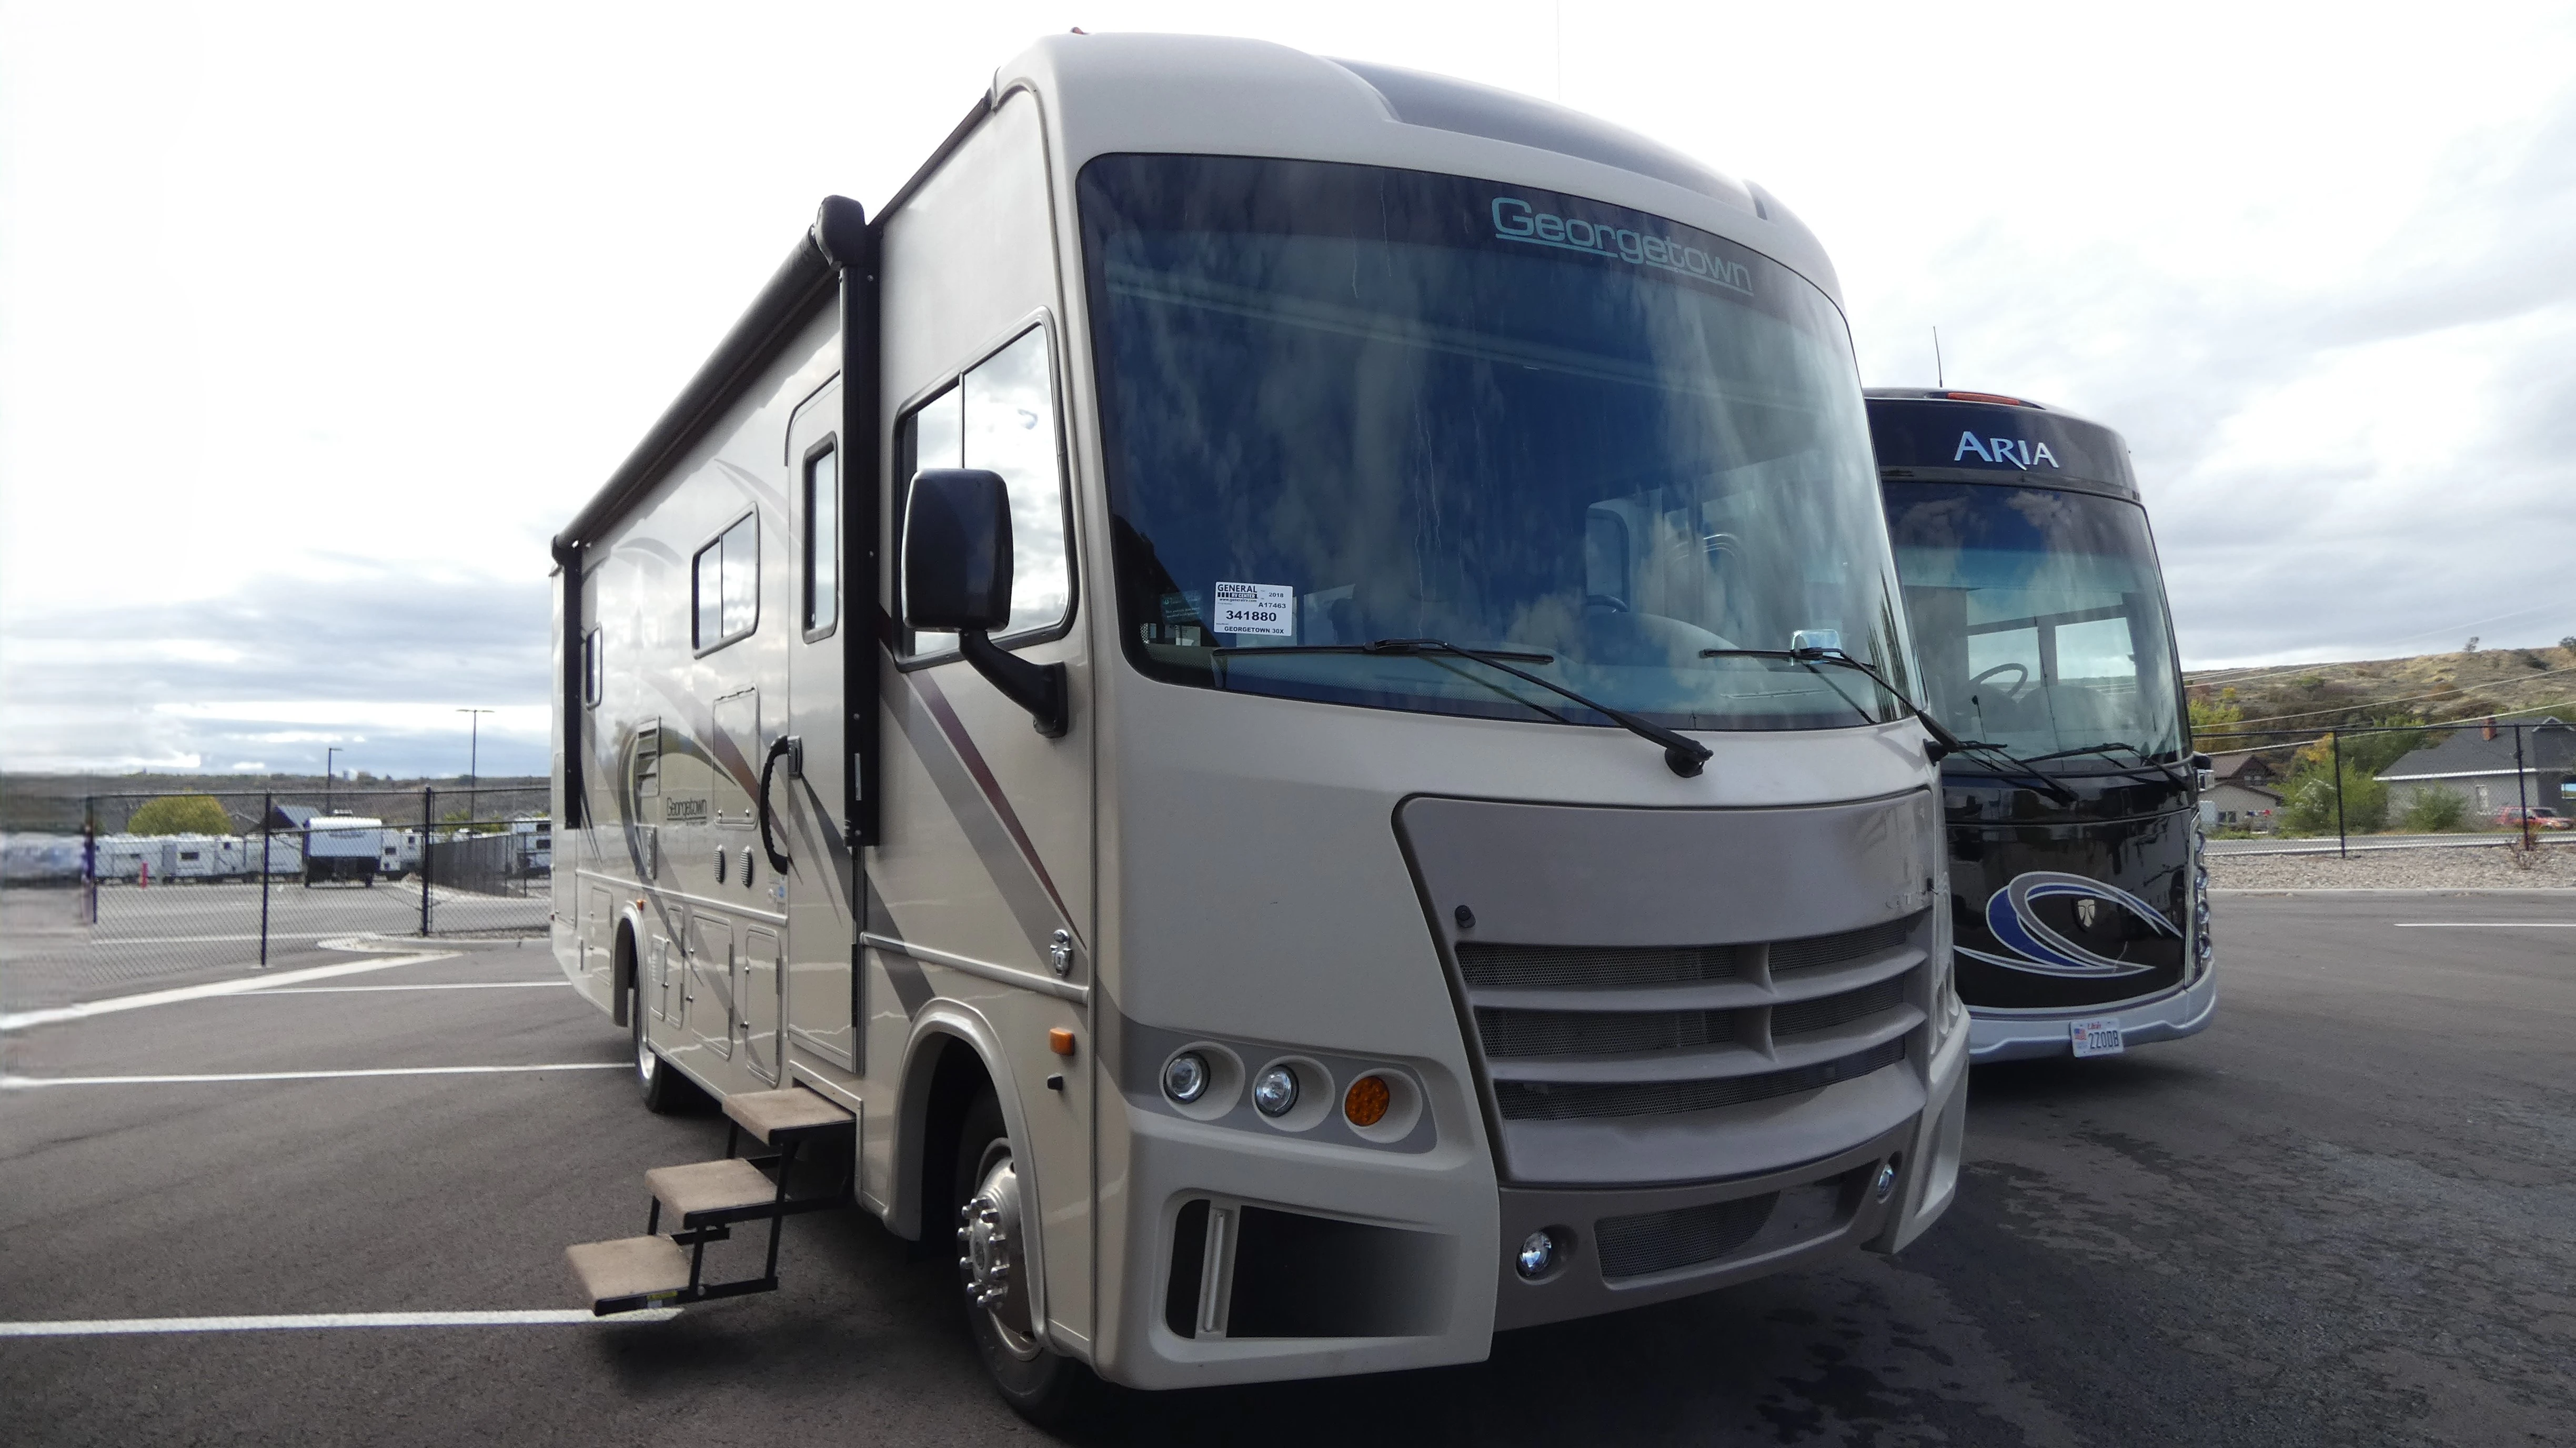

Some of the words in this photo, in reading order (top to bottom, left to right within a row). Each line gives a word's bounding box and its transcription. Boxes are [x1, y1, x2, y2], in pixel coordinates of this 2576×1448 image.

[1491, 197, 1753, 293] Georgetown
[1954, 431, 2059, 470] ARIA
[1217, 584, 1257, 593] GENERAL
[1226, 610, 1277, 622] 341880
